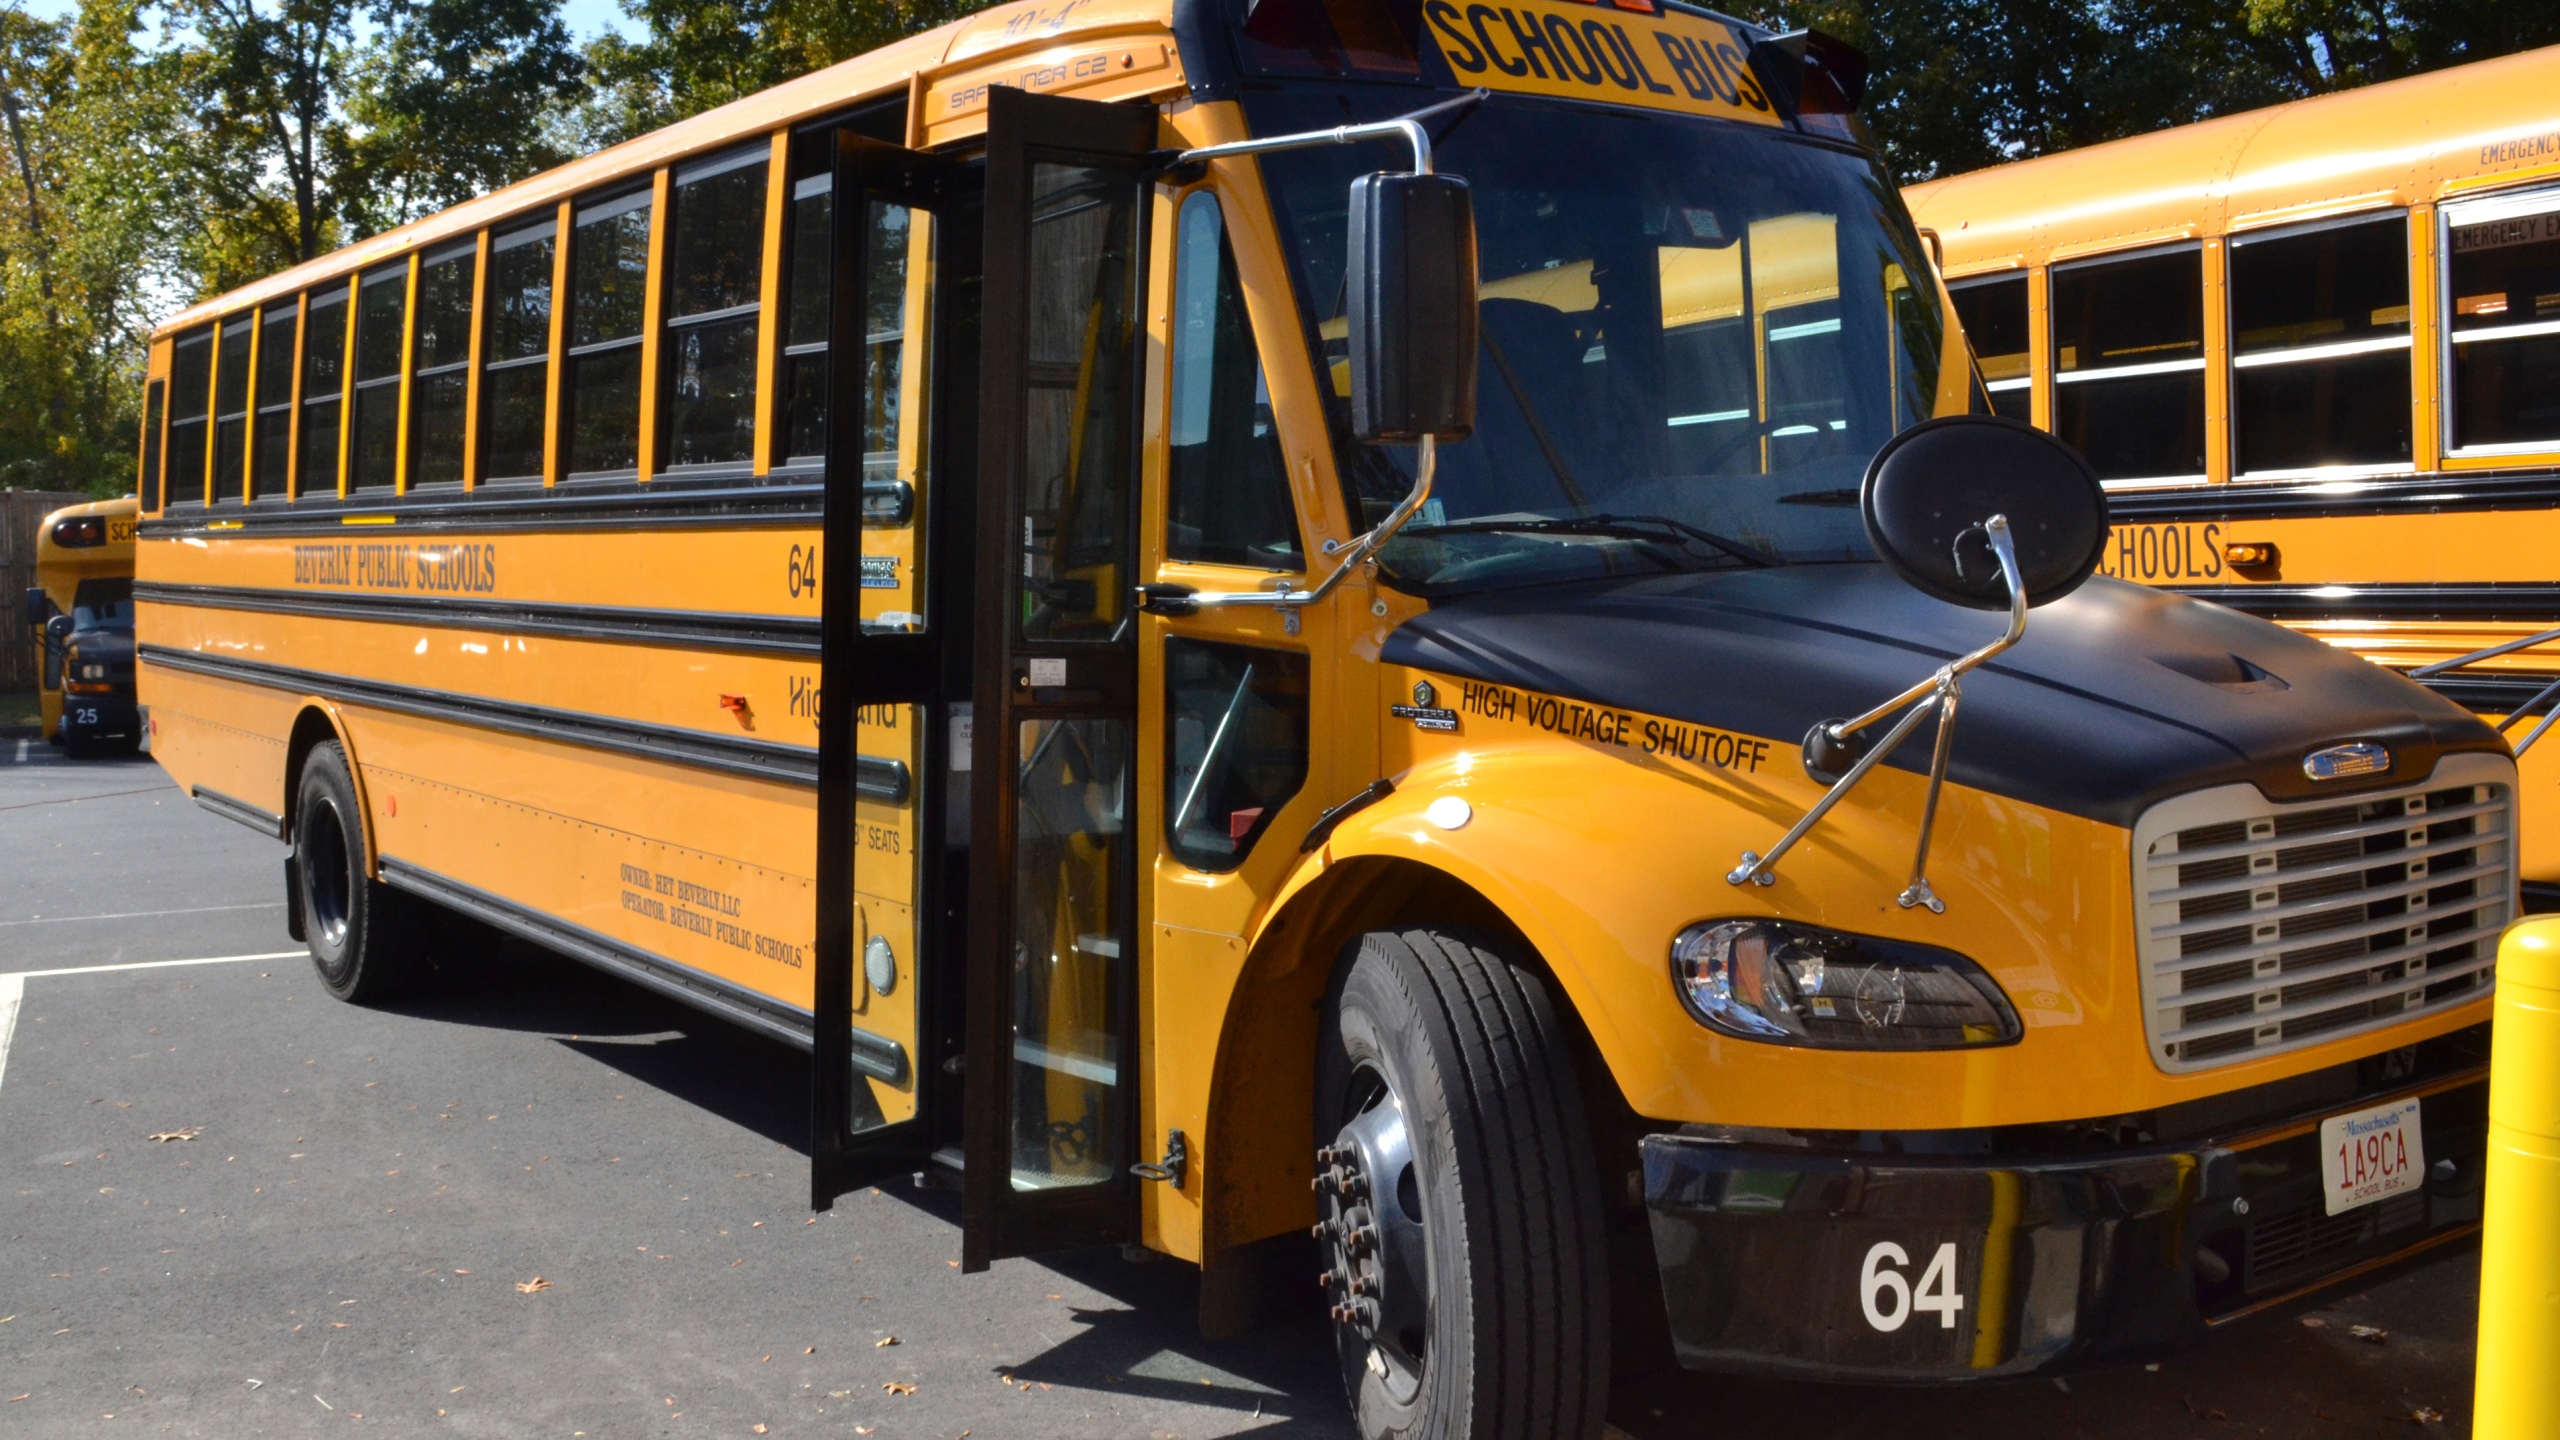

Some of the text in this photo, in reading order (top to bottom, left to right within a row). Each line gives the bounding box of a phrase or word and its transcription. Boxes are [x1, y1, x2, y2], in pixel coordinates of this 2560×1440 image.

[1075, 56, 1108, 78] C2
[1425, 0, 1769, 111] SCHOOL BUS
[2455, 218, 2537, 250] EMERGENCY
[112, 522, 136, 541] SCH
[2100, 523, 2222, 579] CHOOLS
[294, 543, 495, 593] BEVERLY PUBLIC SCHOOLS
[788, 543, 816, 599] 64
[76, 708, 98, 724] 25
[1462, 681, 1770, 773] HIGH VOLTAGE SHUTOFF
[868, 825, 900, 855] SEATS
[620, 863, 653, 890] OWNER:
[655, 874, 675, 897] HET
[621, 889, 802, 969] OPERATOR: BEVERLY PUBLIC SCHOOLS
[2347, 1111, 2400, 1137] Massachusetts
[2339, 1126, 2408, 1190] 1A9CA
[2354, 1176, 2399, 1200] SCHOOL BUS
[1859, 1241, 1964, 1333] 64
